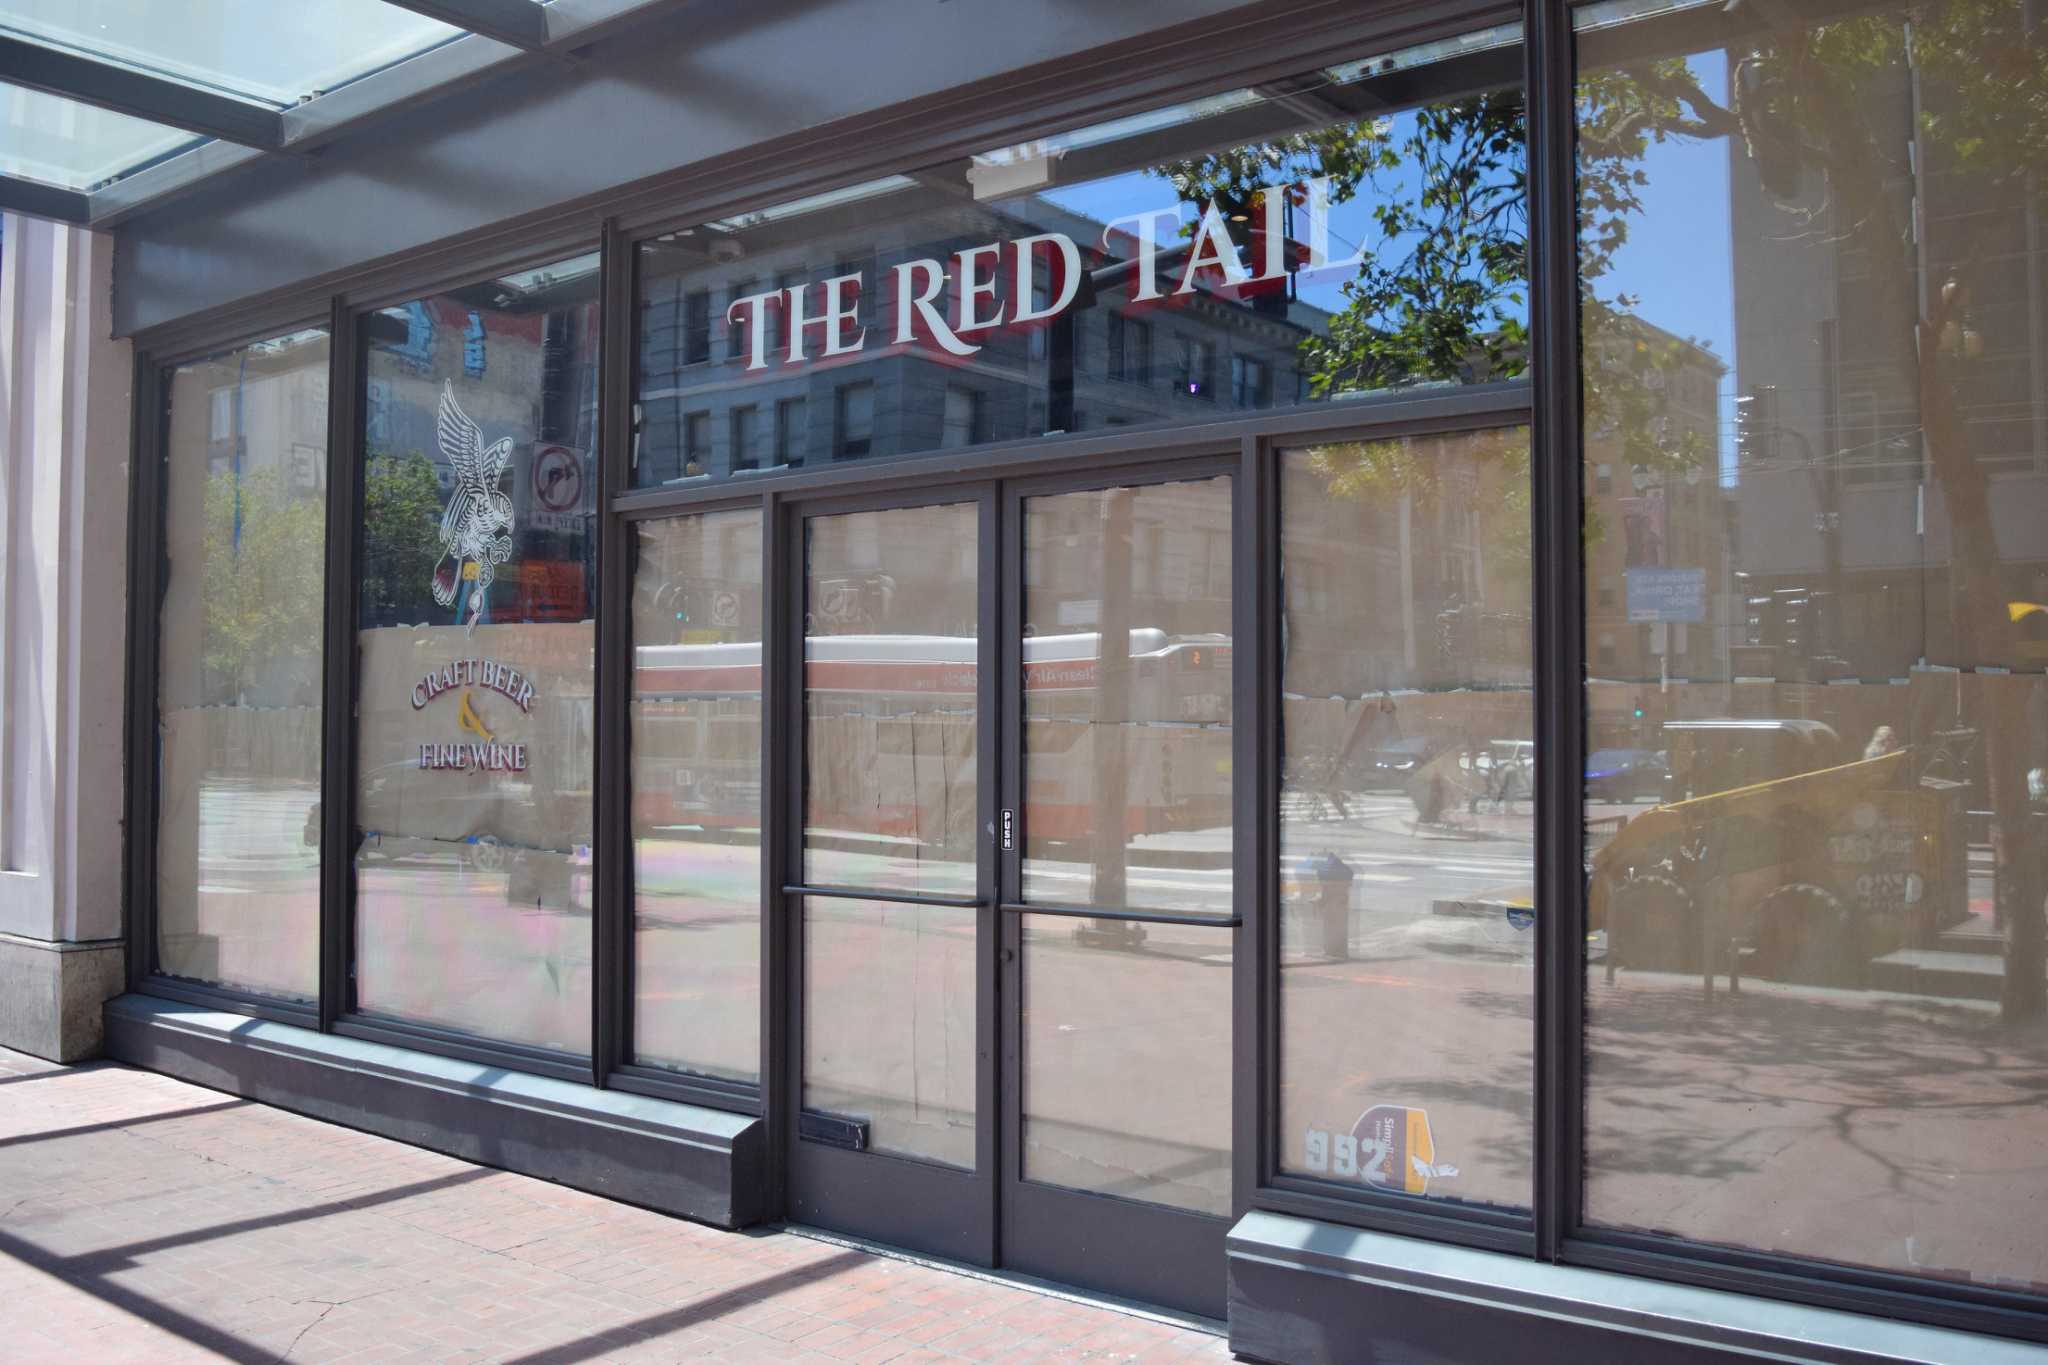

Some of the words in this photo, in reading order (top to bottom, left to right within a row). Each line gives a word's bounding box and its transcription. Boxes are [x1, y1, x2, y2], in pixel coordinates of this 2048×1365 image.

[727, 271, 866, 371] THE
[891, 232, 1083, 356] RED
[1102, 173, 1368, 302] TAIL
[411, 658, 480, 710] CRAFT
[480, 659, 534, 713] BEER
[420, 743, 466, 770] FINE
[468, 742, 528, 772] WINE
[1305, 1128, 1387, 1183] 992
